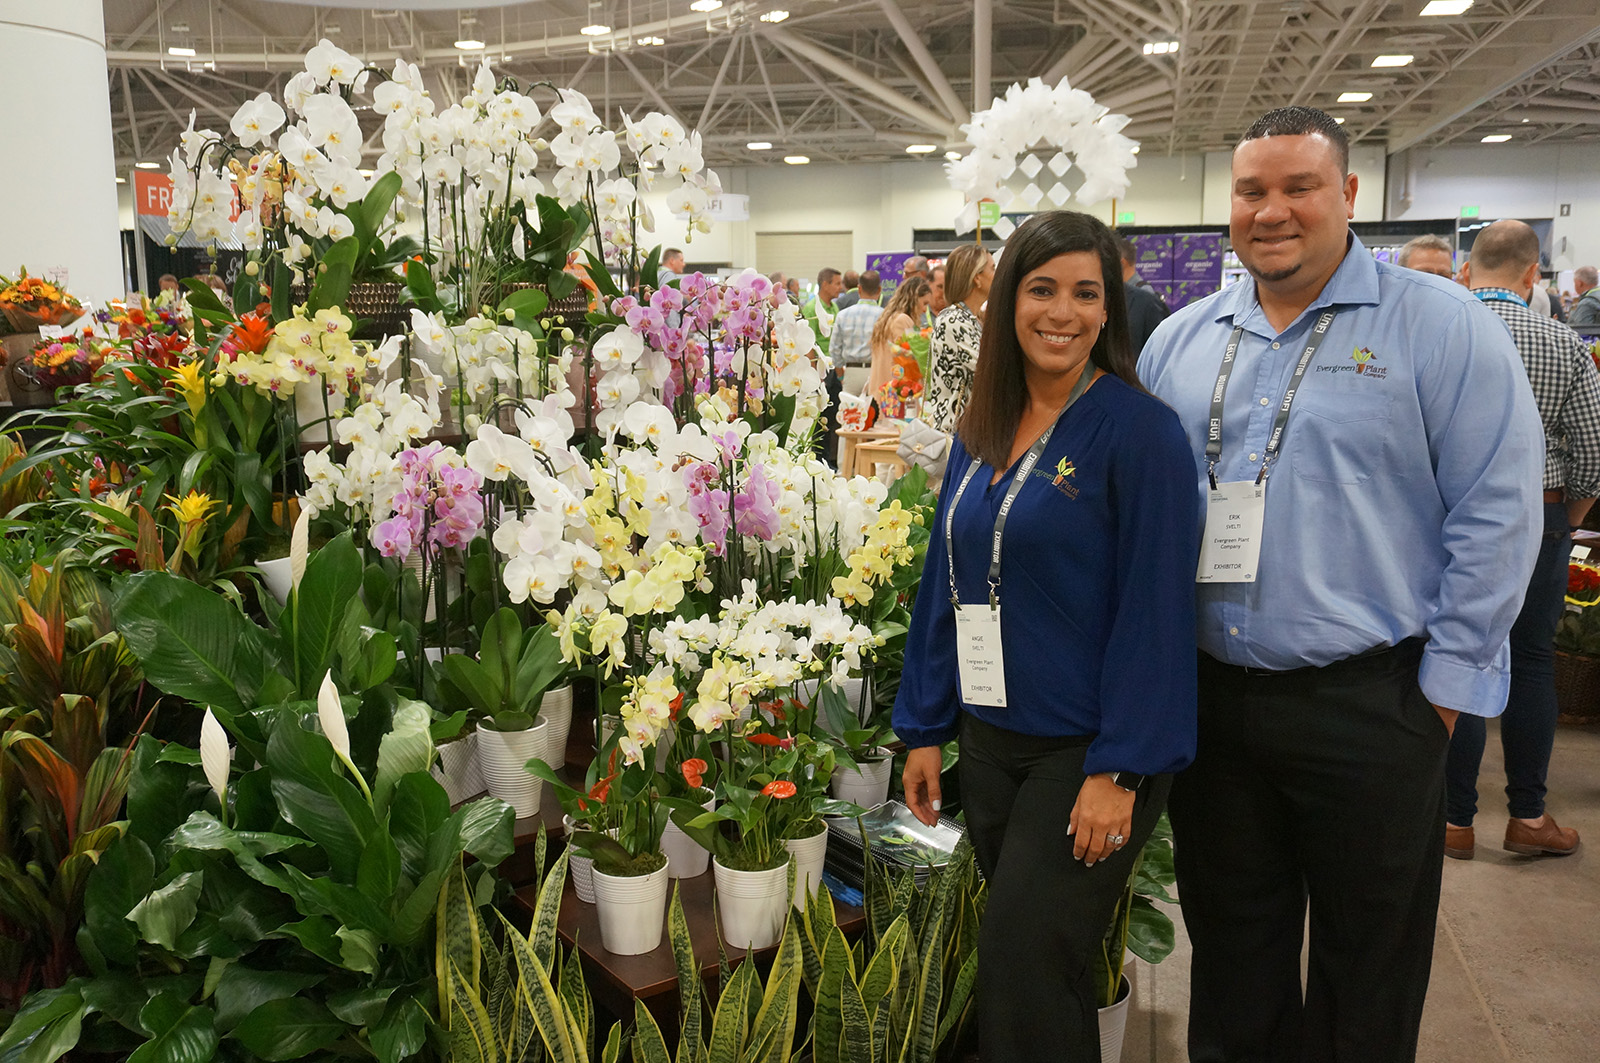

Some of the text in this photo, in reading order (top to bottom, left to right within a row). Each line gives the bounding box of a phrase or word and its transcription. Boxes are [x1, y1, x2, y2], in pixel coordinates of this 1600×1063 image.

[1136, 261, 1163, 269] organic
[1185, 260, 1214, 269] organic
[1316, 313, 1333, 333] UNFI
[1224, 344, 1237, 363] UNFI
[1295, 347, 1315, 376] EXHIBITOR
[1316, 365, 1388, 375] Evergreen Plant
[1363, 372, 1387, 380] Company
[1213, 375, 1227, 403] EXHIBITOR
[1282, 390, 1295, 411] UNFI
[1210, 418, 1219, 440] UNFI
[1016, 452, 1038, 482] EXHIBITOR
[1061, 479, 1080, 496] Plant
[1000, 494, 1015, 516] UNFI
[993, 530, 1002, 564] EXHIBITOR
